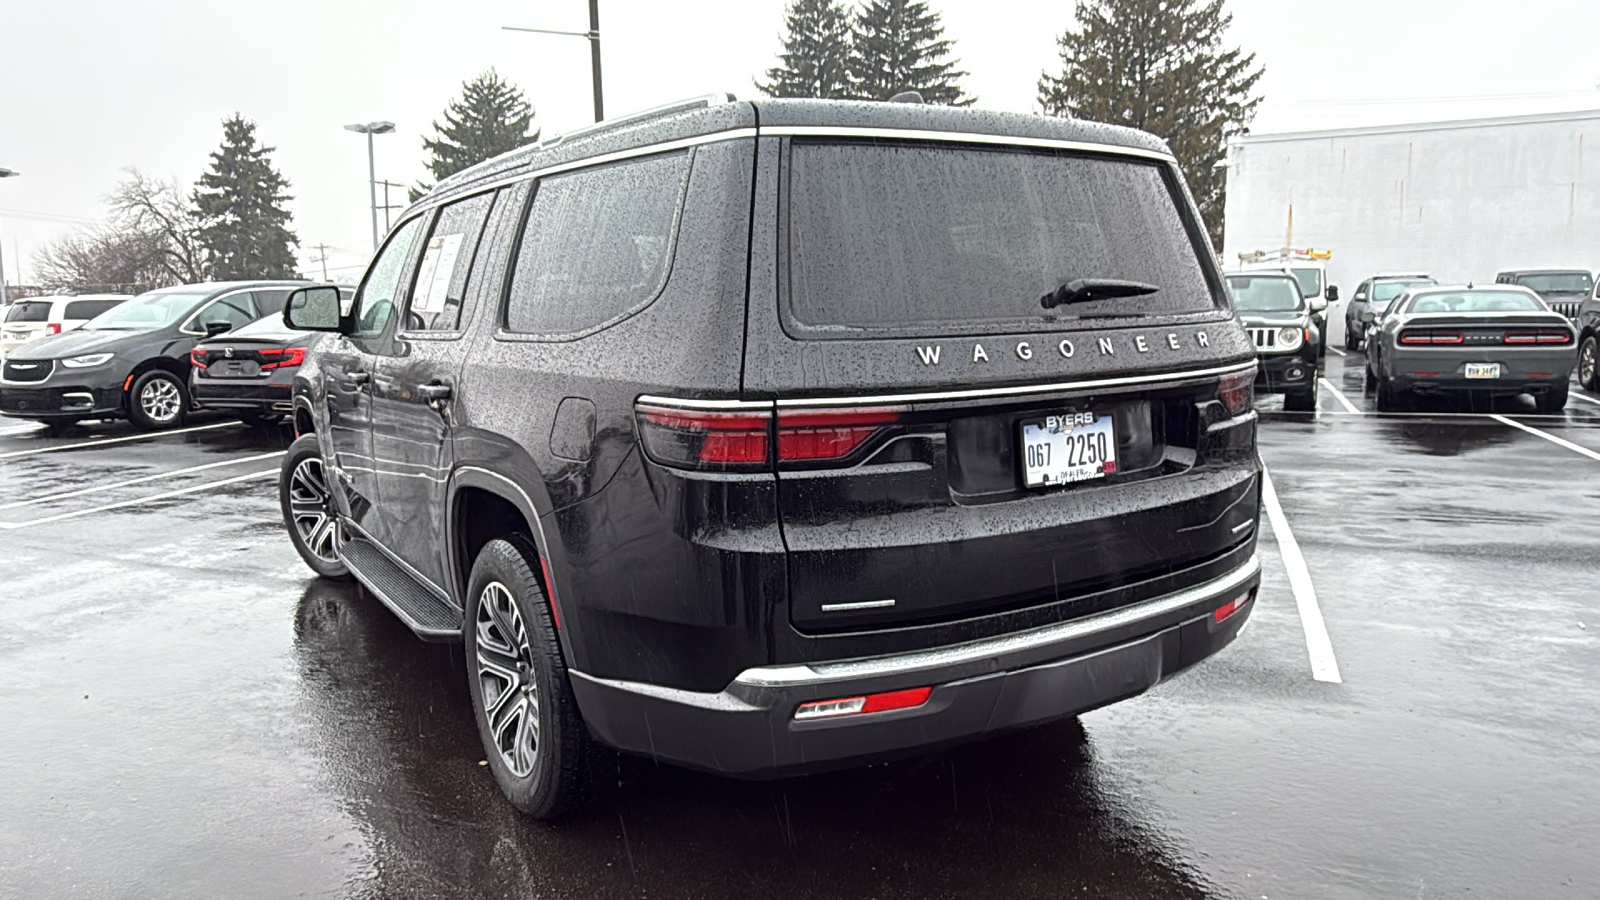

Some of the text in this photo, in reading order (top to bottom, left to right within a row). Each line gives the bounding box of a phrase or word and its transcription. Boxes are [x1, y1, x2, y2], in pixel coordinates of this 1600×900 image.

[916, 331, 1210, 365] WAGONEER
[1046, 411, 1094, 429] BYERS
[1027, 431, 1108, 468] 067 2250
